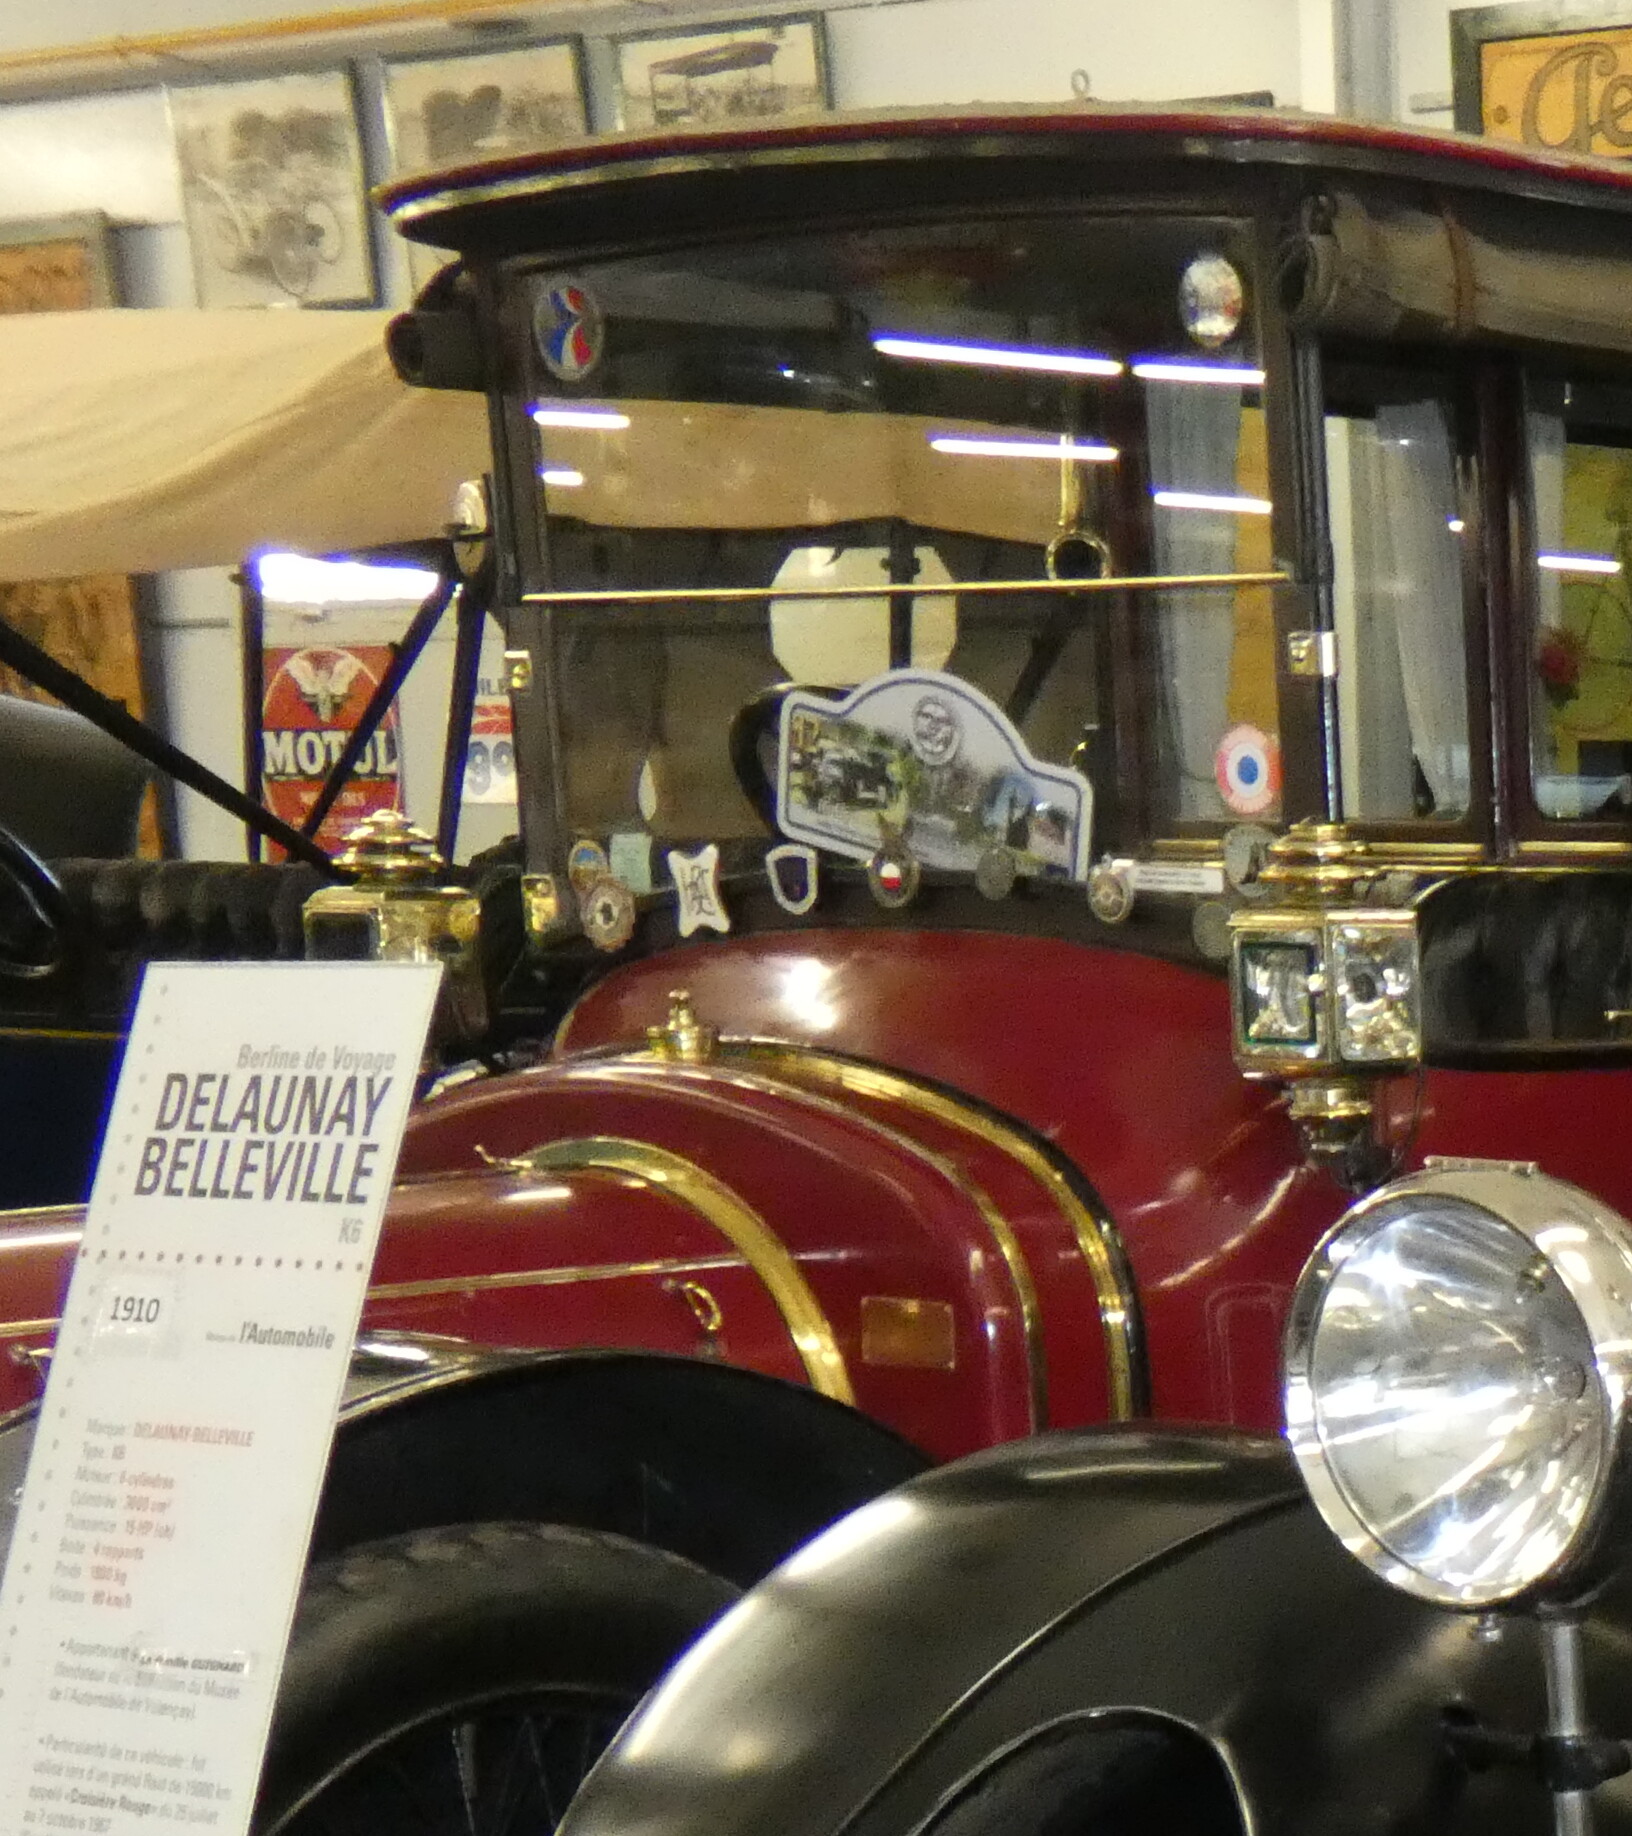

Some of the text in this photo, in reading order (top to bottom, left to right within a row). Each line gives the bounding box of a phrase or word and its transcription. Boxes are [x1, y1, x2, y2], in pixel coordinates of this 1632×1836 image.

[304, 1045, 327, 1070] de
[333, 1044, 397, 1077] Voyage
[155, 1072, 392, 1137] DELAUNAY
[134, 1137, 378, 1205] BELLEVILLE
[110, 1295, 160, 1324] 1910
